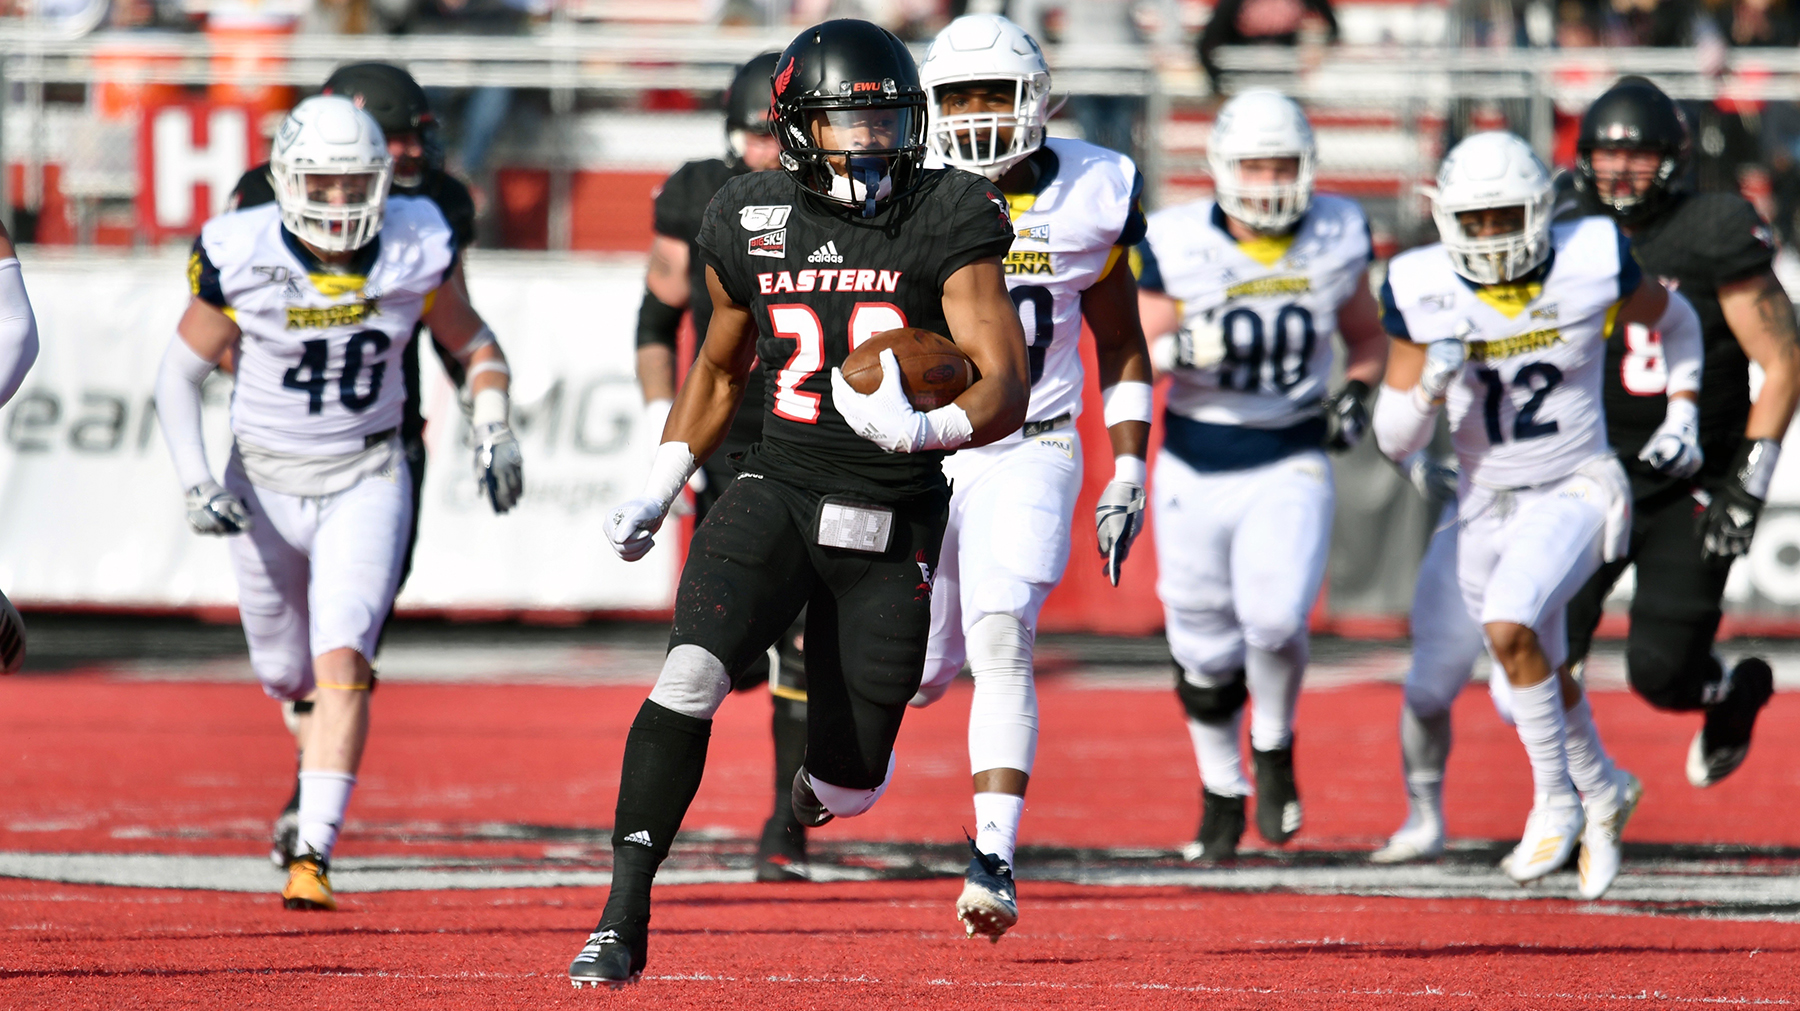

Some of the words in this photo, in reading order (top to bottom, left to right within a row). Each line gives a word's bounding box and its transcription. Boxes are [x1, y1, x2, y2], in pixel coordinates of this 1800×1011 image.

[852, 82, 881, 92] EWU
[153, 106, 248, 229] H
[738, 205, 793, 232] 150
[807, 253, 844, 263] adidas
[757, 268, 903, 295] EASTERN
[283, 329, 391, 415] 46
[1477, 361, 1563, 445] 12
